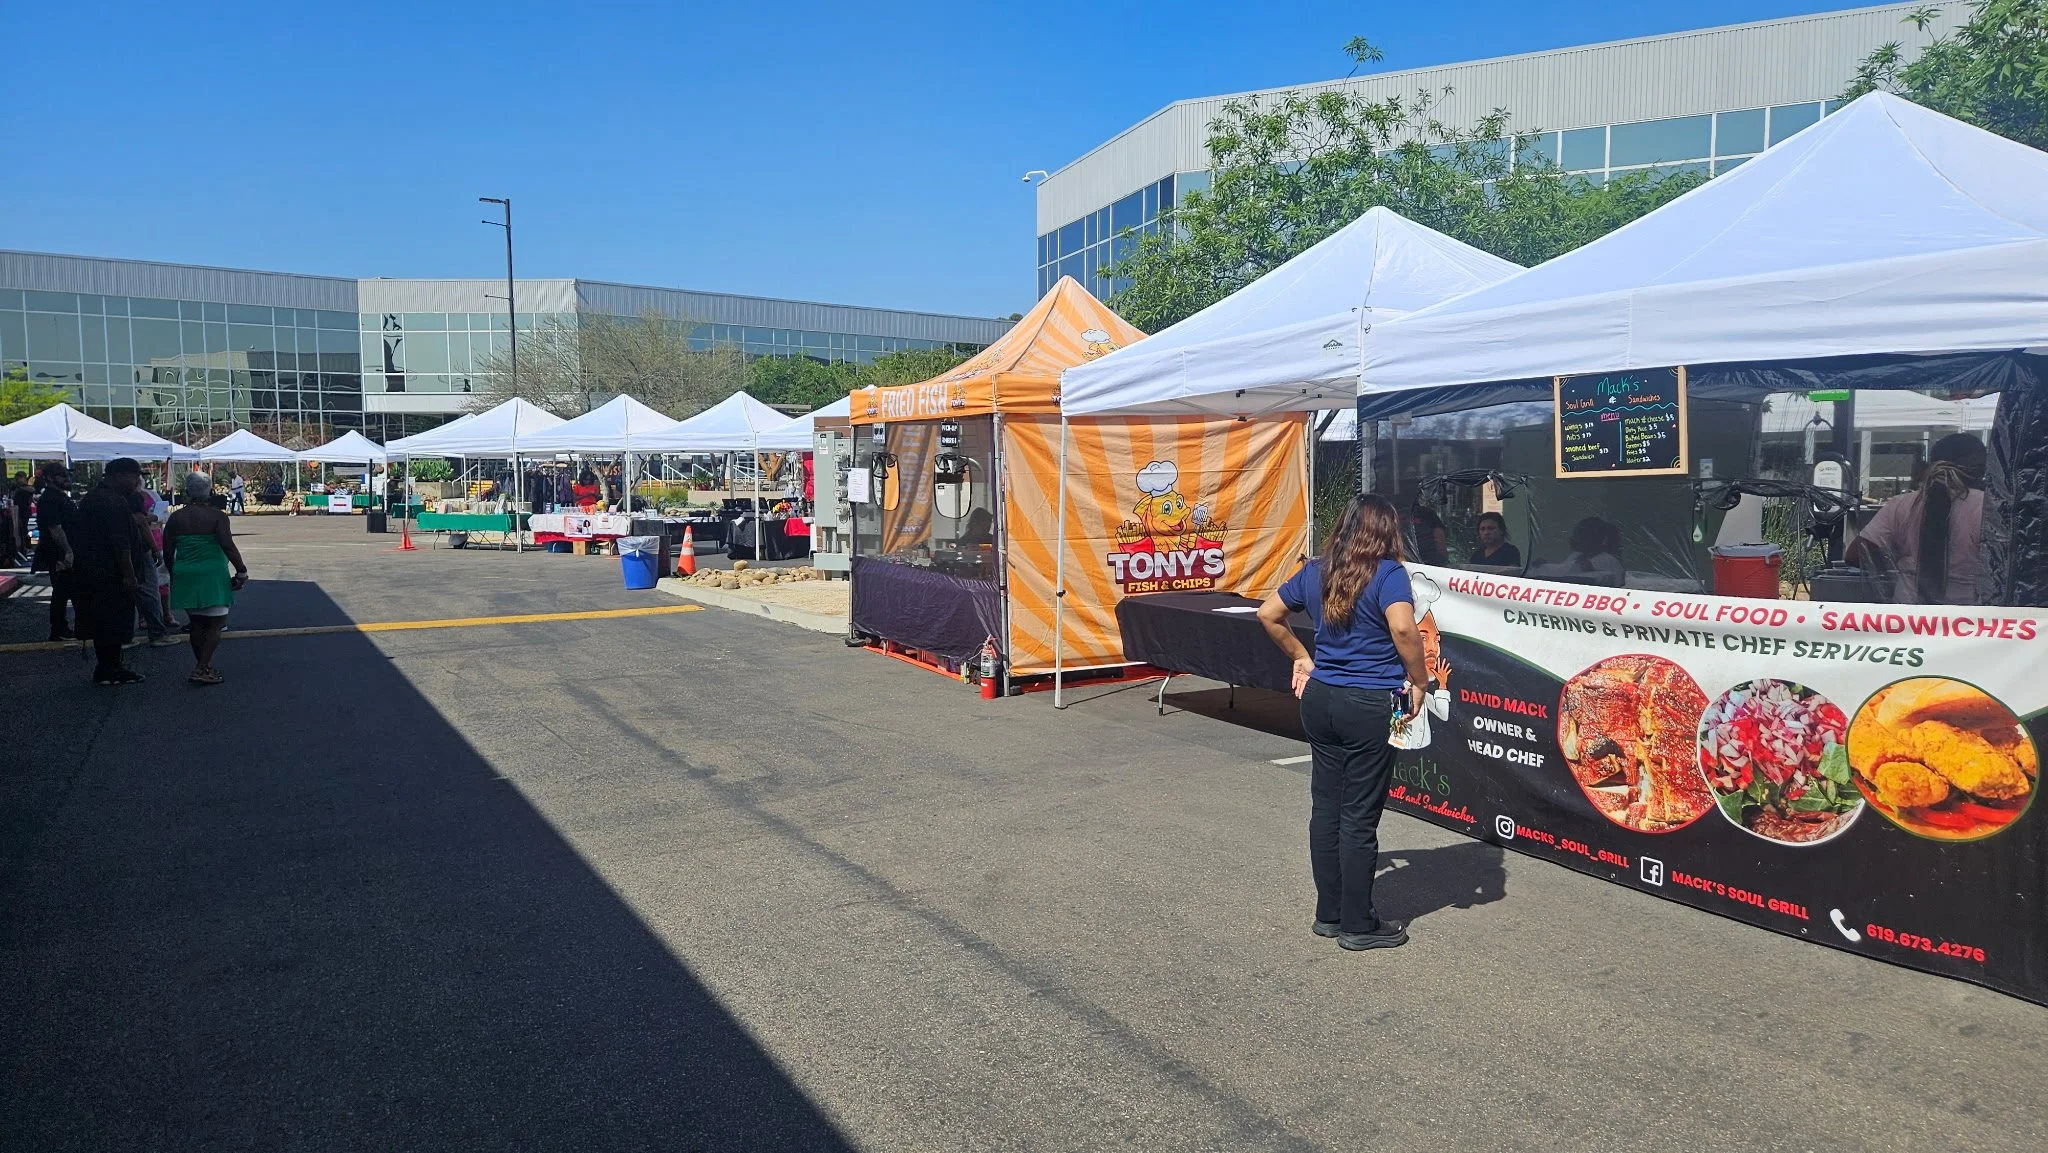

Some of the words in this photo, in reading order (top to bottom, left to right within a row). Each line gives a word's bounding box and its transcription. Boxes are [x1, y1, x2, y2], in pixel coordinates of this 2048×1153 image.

[881, 387, 914, 418] FRIED
[918, 383, 948, 415] FISH
[1597, 375, 1639, 396] Mack's
[1566, 399, 1579, 410] Soul
[1108, 548, 1225, 580] TONY'S
[1128, 582, 1158, 592] FISH
[1161, 580, 1170, 590] &
[1172, 577, 1211, 590] CHIPS
[1448, 576, 1580, 607] HANDCRAFTED
[1582, 594, 1627, 615] BBQ
[1651, 600, 1709, 621] SOUL
[1716, 605, 1788, 627] FOOD
[1821, 611, 2037, 641] SANDWICHES
[1503, 608, 1597, 635] CATERING
[1601, 621, 1619, 638] &
[1621, 623, 1716, 649] PRIVATE
[1722, 633, 1787, 656] CHEF
[1792, 640, 1925, 667] SERVICES
[1460, 688, 1501, 709] DAVID
[1503, 697, 1548, 719] MACK
[1473, 716, 1523, 739] OWNER
[1525, 728, 1538, 743] &
[1467, 739, 1504, 759] HEAD
[1506, 748, 1545, 768] CHEF
[1388, 785, 1406, 800] rill
[1405, 793, 1422, 806] and
[1422, 794, 1478, 824] Sandwiches
[1515, 824, 1630, 869] MACKS_SOUL_GRILL
[1672, 870, 1725, 896] MACK'S
[1727, 886, 1765, 909] SOUL
[1767, 897, 1810, 921] GRILL
[1866, 922, 1986, 963] 619.673.4276
